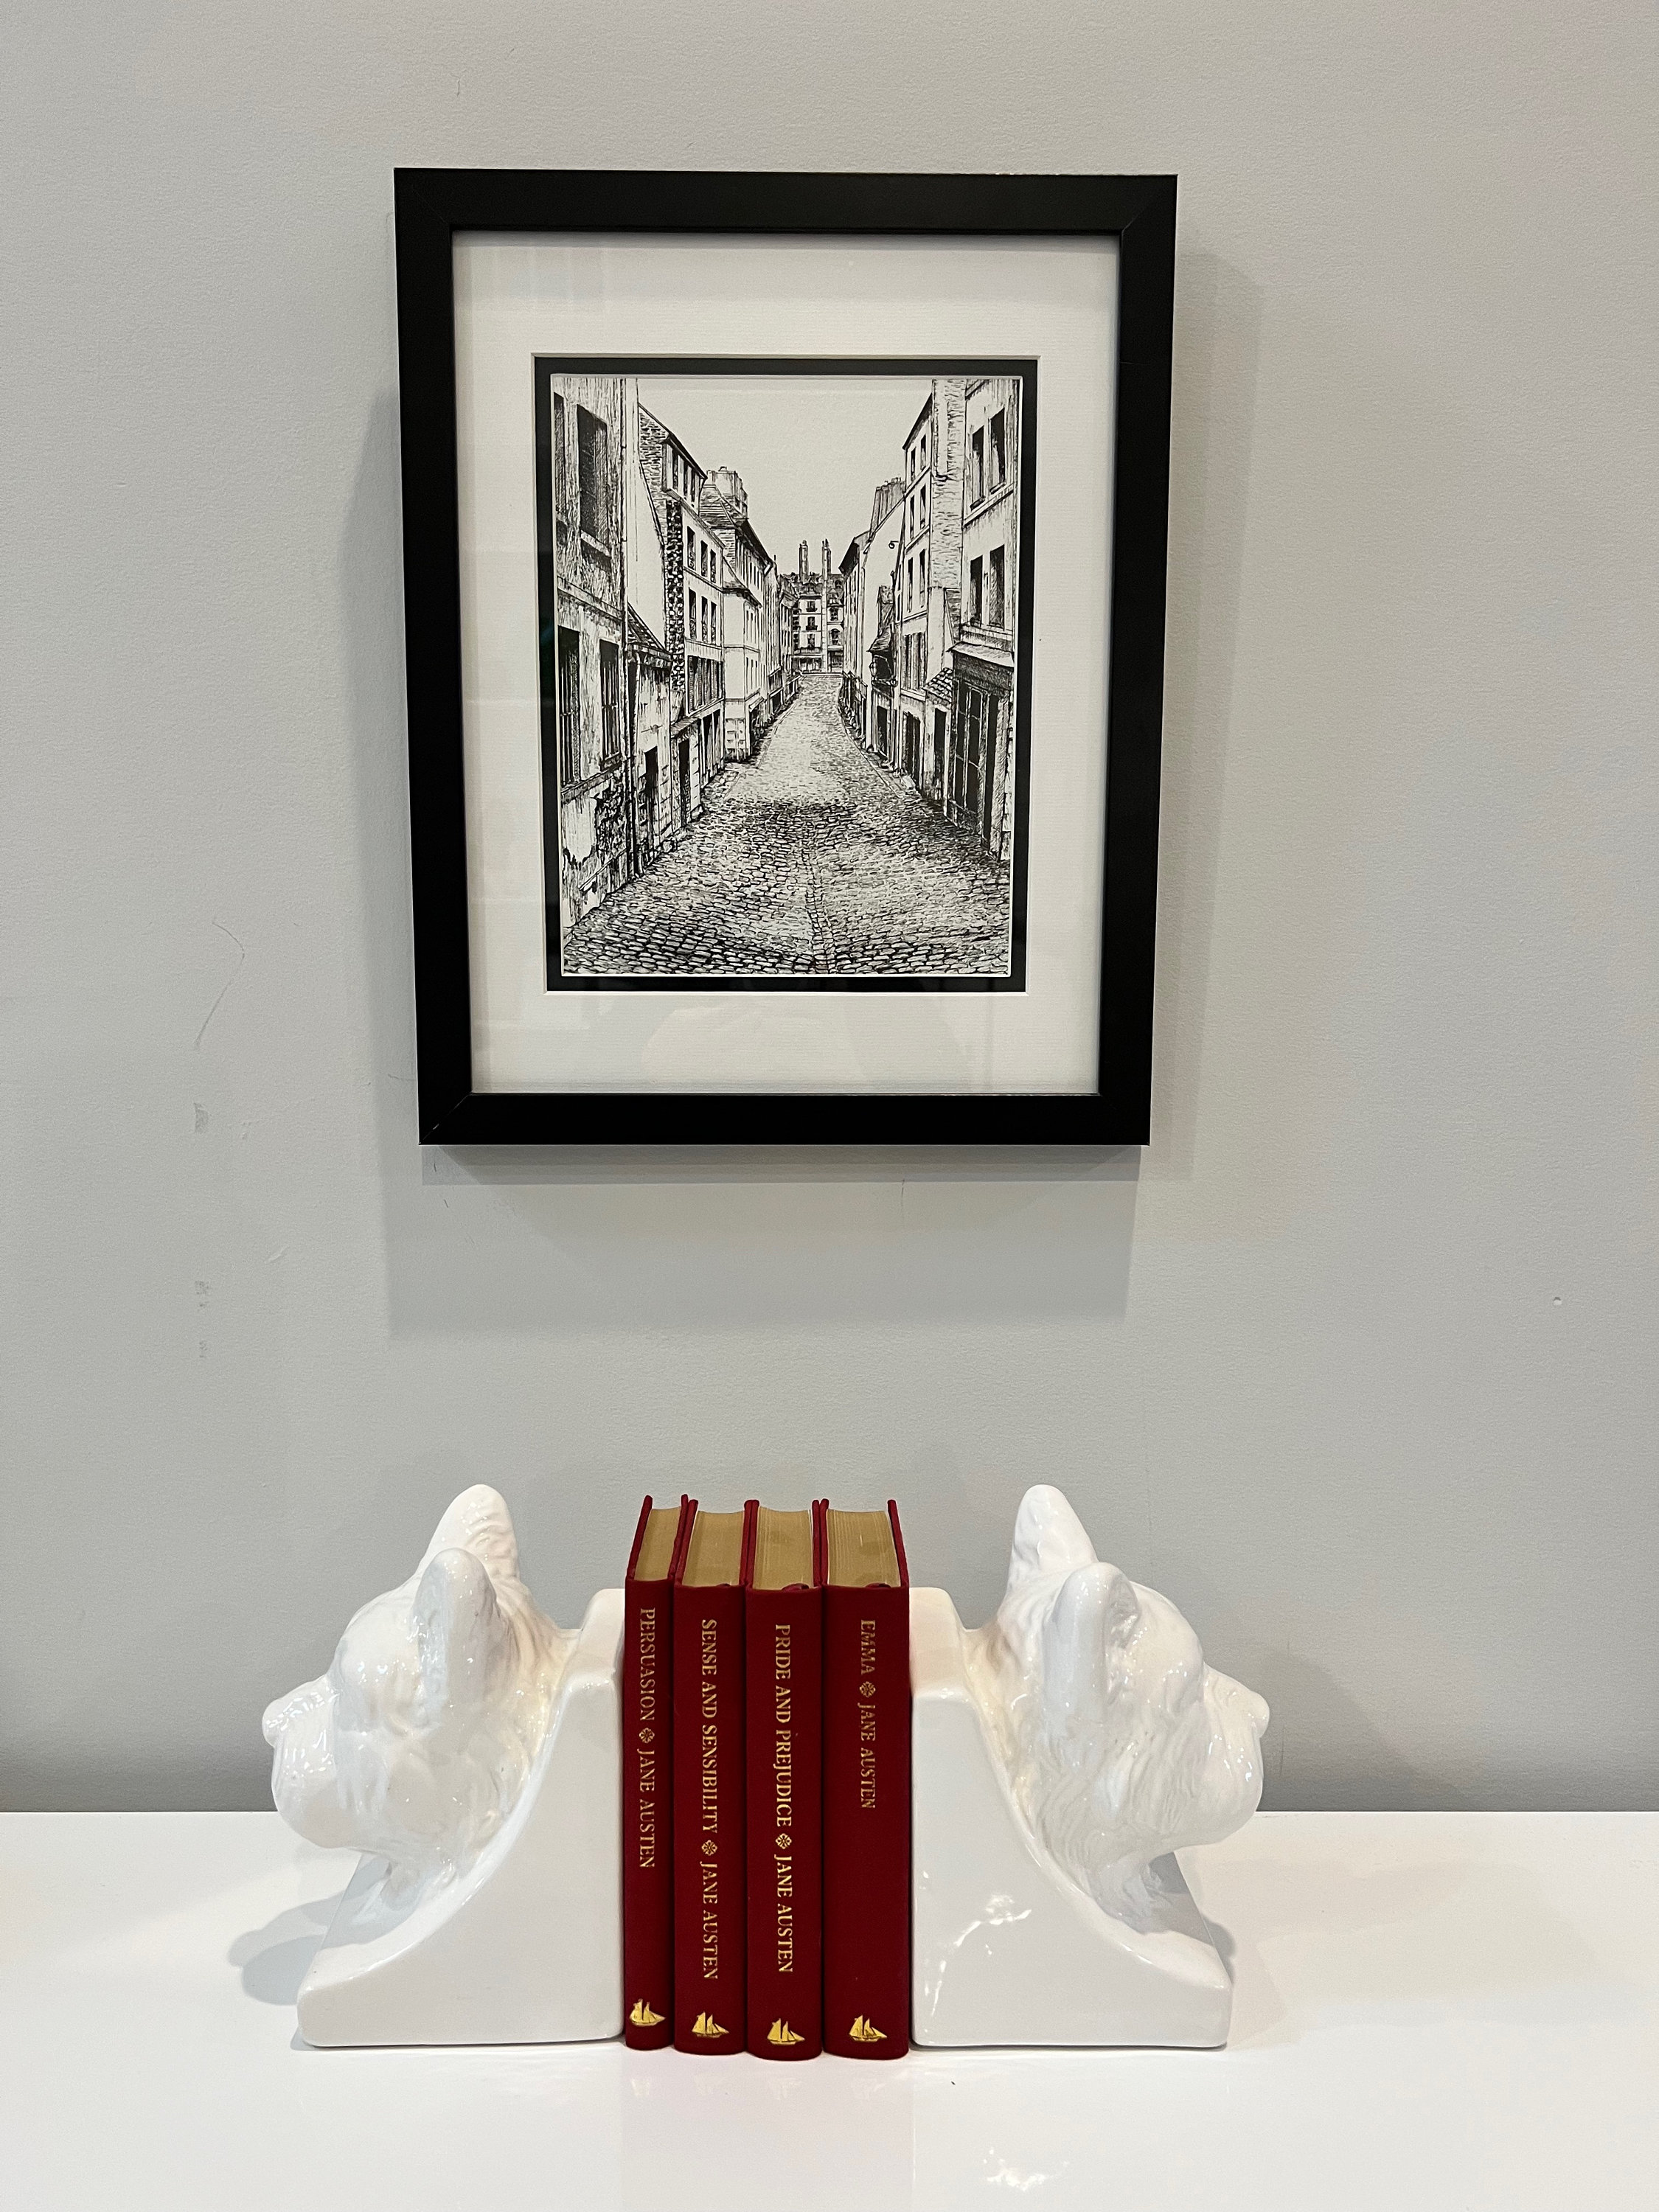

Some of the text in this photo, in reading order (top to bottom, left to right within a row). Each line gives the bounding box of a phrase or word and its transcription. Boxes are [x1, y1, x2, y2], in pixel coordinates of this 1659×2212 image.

[638, 1607, 655, 1868] PERSUASION JANE AUSTEN
[699, 1619, 718, 1980] SENSE AND SENSIBILITY JANE AUSTEN
[772, 1624, 793, 1972] PRIDE AND PREJUDICE JANE AUSTEN
[857, 1619, 876, 1809] EMMA JANE AUSTEN
